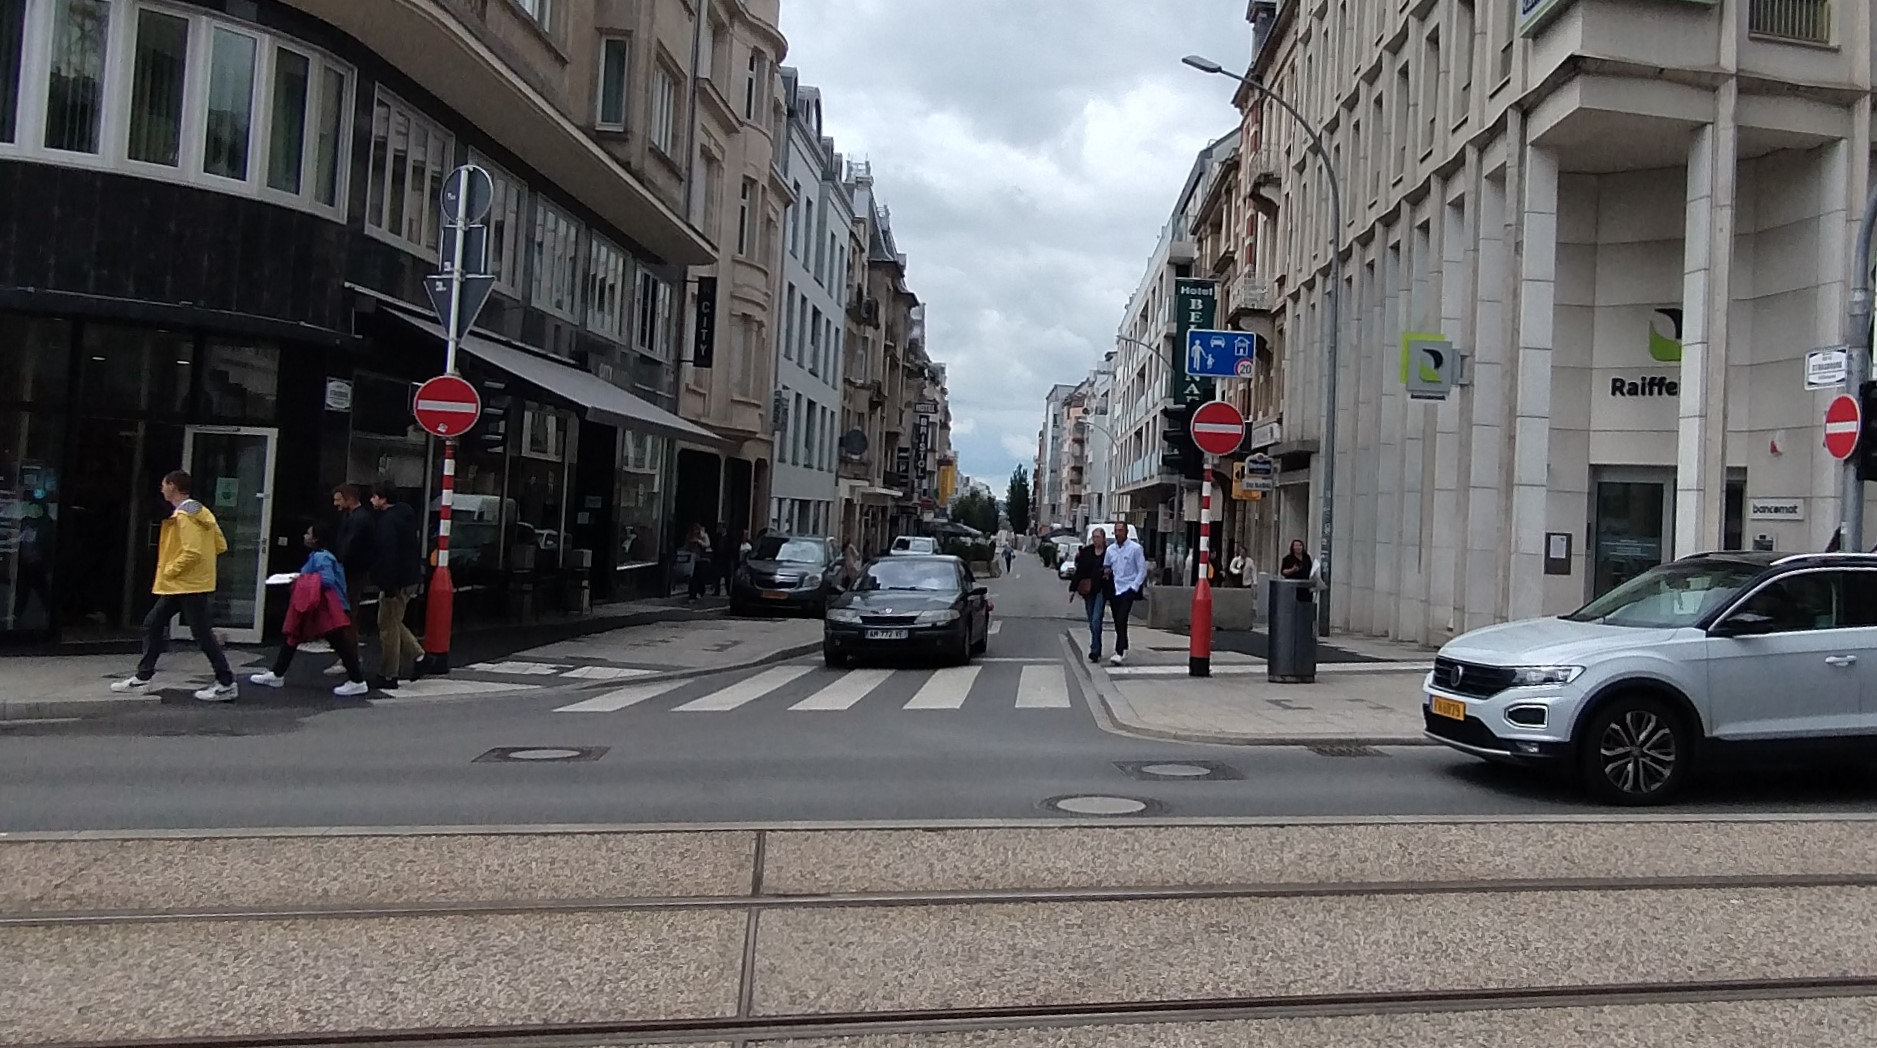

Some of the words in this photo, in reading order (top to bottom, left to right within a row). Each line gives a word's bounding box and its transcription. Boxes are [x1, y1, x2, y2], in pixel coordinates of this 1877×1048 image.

[1180, 285, 1214, 297] Hotel
[699, 300, 710, 356] CITY
[1240, 363, 1252, 374] 20
[917, 417, 928, 476] BRISTOL
[1752, 503, 1799, 515] bancomat
